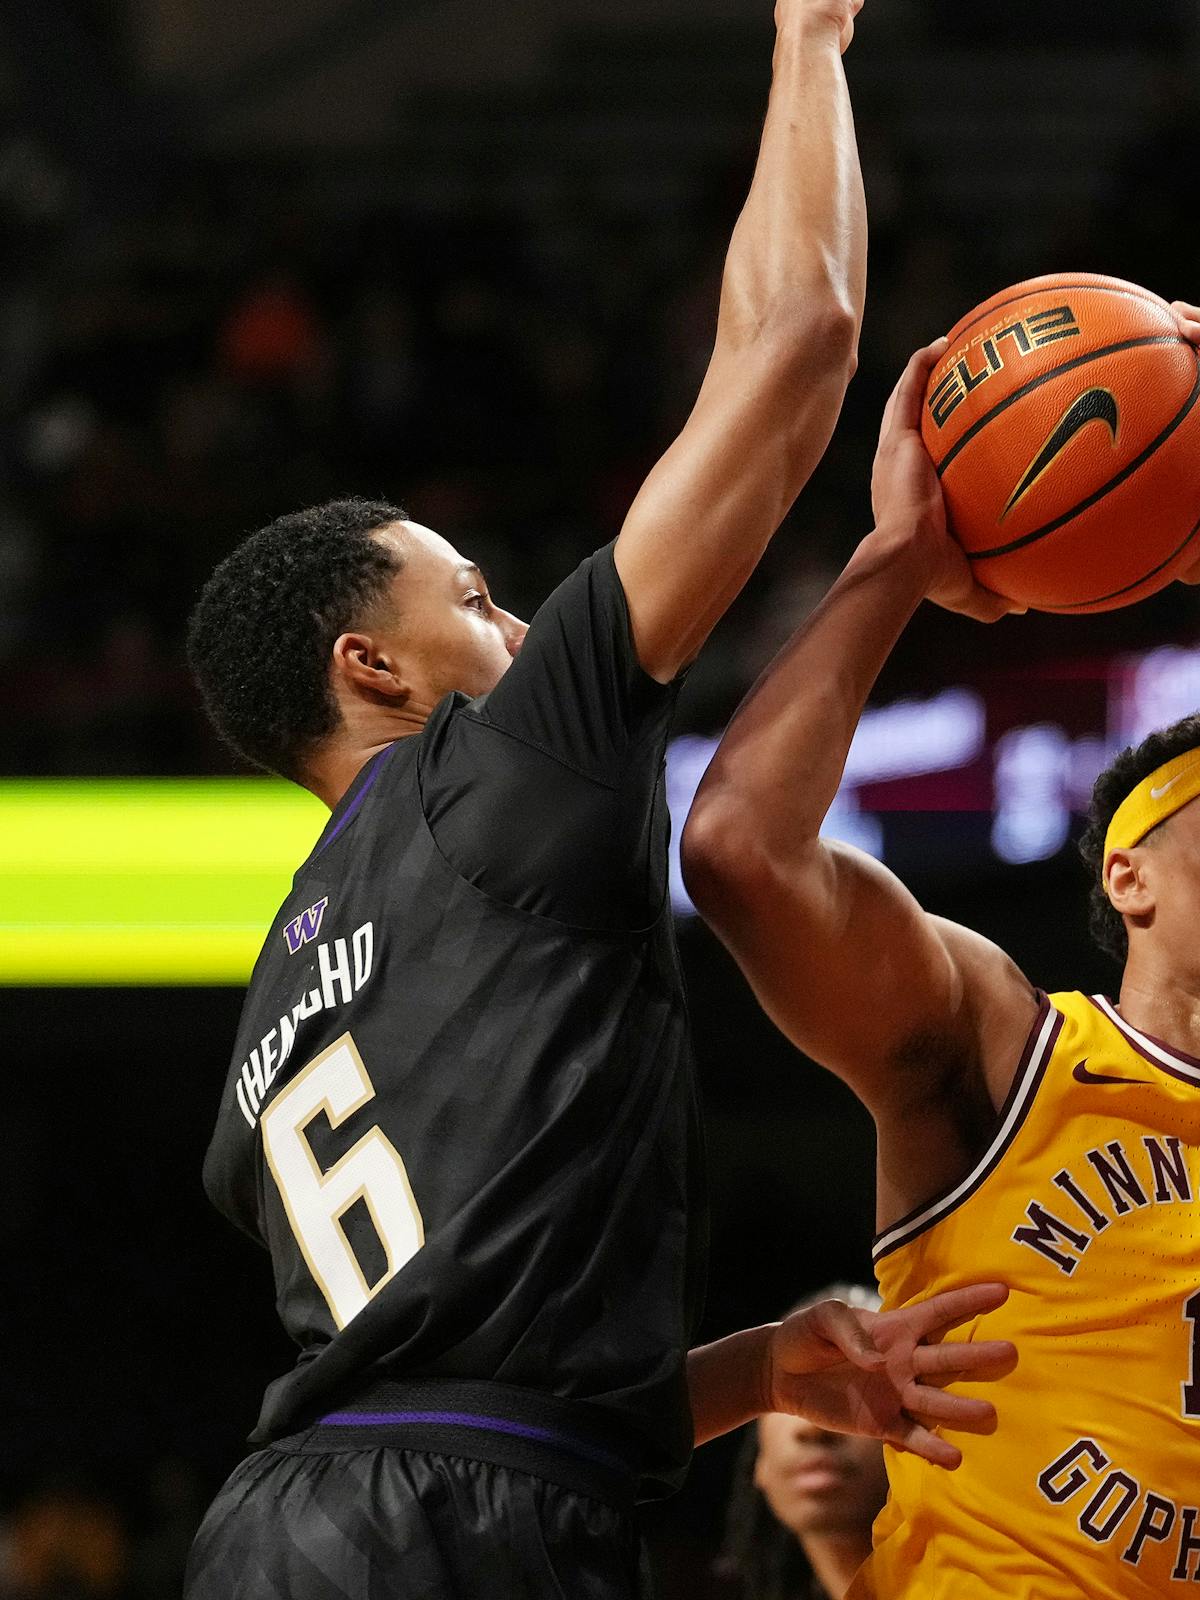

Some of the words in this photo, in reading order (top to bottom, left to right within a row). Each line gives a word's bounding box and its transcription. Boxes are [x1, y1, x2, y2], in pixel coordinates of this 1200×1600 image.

[927, 305, 1081, 430] ELITE
[283, 896, 328, 955] W
[260, 1031, 425, 1332] 6
